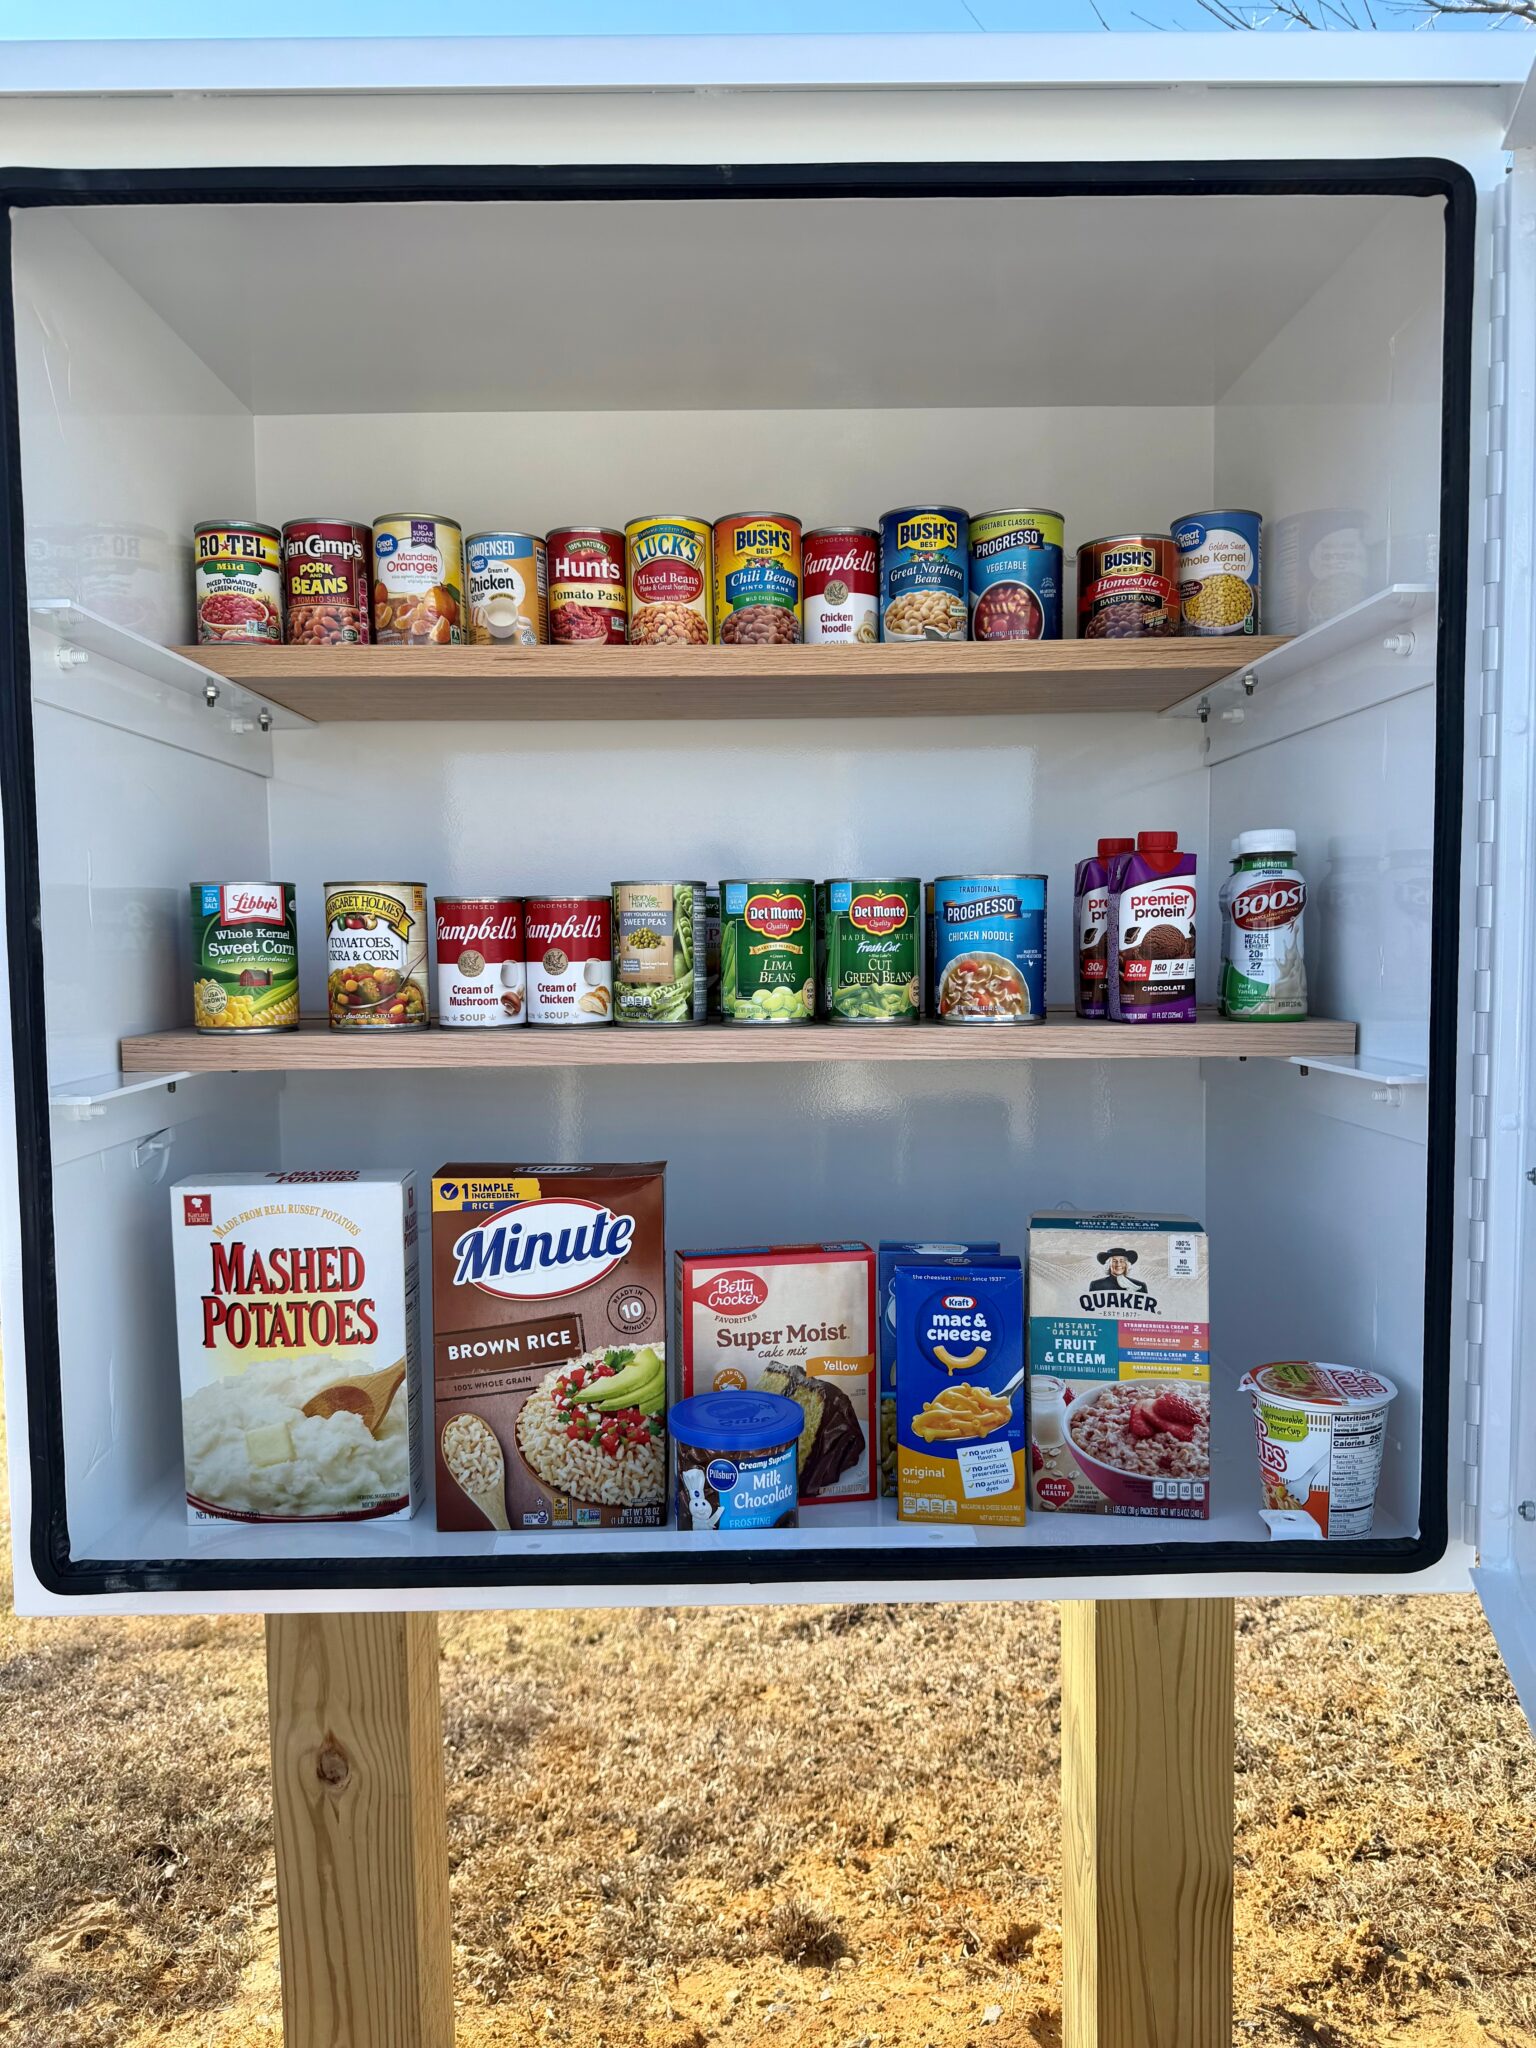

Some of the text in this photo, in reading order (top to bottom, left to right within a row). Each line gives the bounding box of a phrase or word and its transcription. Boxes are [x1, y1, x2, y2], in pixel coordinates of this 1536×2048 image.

[979, 520, 1006, 531] VEGETABLE
[737, 529, 790, 550] BUSH'S
[976, 531, 1038, 558] PROGRESSO
[468, 541, 514, 556] CONDENSED
[636, 535, 697, 563] LUCK'S
[398, 553, 437, 562] Mandarin
[804, 549, 875, 577] Campbell's
[1104, 552, 1152, 570] BUSH'S
[1179, 553, 1246, 568] Whole Kernel
[217, 563, 244, 571] Mild
[300, 563, 333, 575] PORK
[387, 562, 438, 574] Oranges
[891, 564, 962, 581] Great Northern
[986, 561, 1027, 573] VEGETABLE
[1223, 563, 1245, 571] Corn
[207, 579, 257, 588] DICED TOMATOES
[292, 577, 347, 594] BEANS
[470, 575, 514, 594] Chicken
[638, 573, 698, 585] Mixed Beans
[731, 570, 795, 587] Chili Beans
[915, 575, 941, 584] Beans
[1097, 577, 1159, 592] Homestyle
[233, 587, 254, 595] CHILIES
[553, 590, 624, 602] Tomato Paste
[1100, 595, 1155, 606] BAKED BEANS
[821, 614, 853, 622] Chicken
[822, 623, 852, 633] Noodle
[229, 892, 278, 914] Libby's
[1131, 893, 1189, 909] premier
[1234, 884, 1306, 918] BOOST
[751, 907, 802, 919] Del Monte
[948, 898, 1015, 921] PROGRESSO
[1135, 907, 1185, 921] protein
[216, 929, 290, 940] Whole Kernel
[437, 916, 516, 945] Campbell's
[949, 931, 1014, 941] CHICKEN NOODLE
[209, 940, 294, 956] Sweet Corn
[331, 937, 393, 948] TOMATOES,
[763, 960, 793, 971] LIMA
[869, 959, 892, 970] CUT
[1129, 964, 1146, 973] 30g
[760, 972, 795, 982] BEANS
[845, 971, 911, 982] GREEN BEANS
[452, 984, 493, 994] Cream of
[450, 997, 498, 1006] Mushroom
[462, 1183, 513, 1199] 1 SIMPLE
[213, 1217, 240, 1239] MADE
[240, 1208, 264, 1224] FROM
[265, 1205, 286, 1215] REAL
[288, 1204, 321, 1216] RUSSET
[321, 1209, 362, 1237] POTATOES
[457, 1212, 632, 1282] Minute
[210, 1242, 365, 1295] MASHED
[714, 1278, 754, 1294] Betty
[612, 1290, 633, 1304] READY
[708, 1292, 761, 1307] Crocker
[1080, 1292, 1160, 1314] QUAKER
[622, 1302, 641, 1318] 10
[202, 1297, 378, 1349] POTATOES
[623, 1317, 651, 1331] MINUTES
[715, 1313, 757, 1324] FAVORITES
[933, 1313, 986, 1327] mac &
[717, 1323, 847, 1351] Super Moist
[448, 1330, 571, 1360] BROWN RICE
[1055, 1339, 1096, 1350] FRUIT
[758, 1346, 807, 1358] cake mix
[1045, 1352, 1105, 1364] & CREAM
[824, 1361, 858, 1371] Yellow
[454, 1376, 531, 1391] 100% WHOLE GRAIN
[1263, 1409, 1303, 1425] Microwavable
[1270, 1423, 1301, 1437] Paper Cup
[739, 1452, 791, 1470] Creamy Supreme
[710, 1470, 736, 1480] Pillsbury
[902, 1467, 945, 1479] original
[972, 1468, 1008, 1478] preservatives
[754, 1471, 780, 1490] Milk
[987, 1478, 1009, 1486] artificial
[735, 1485, 792, 1509] Chocolate
[730, 1517, 771, 1528] FROSTING
